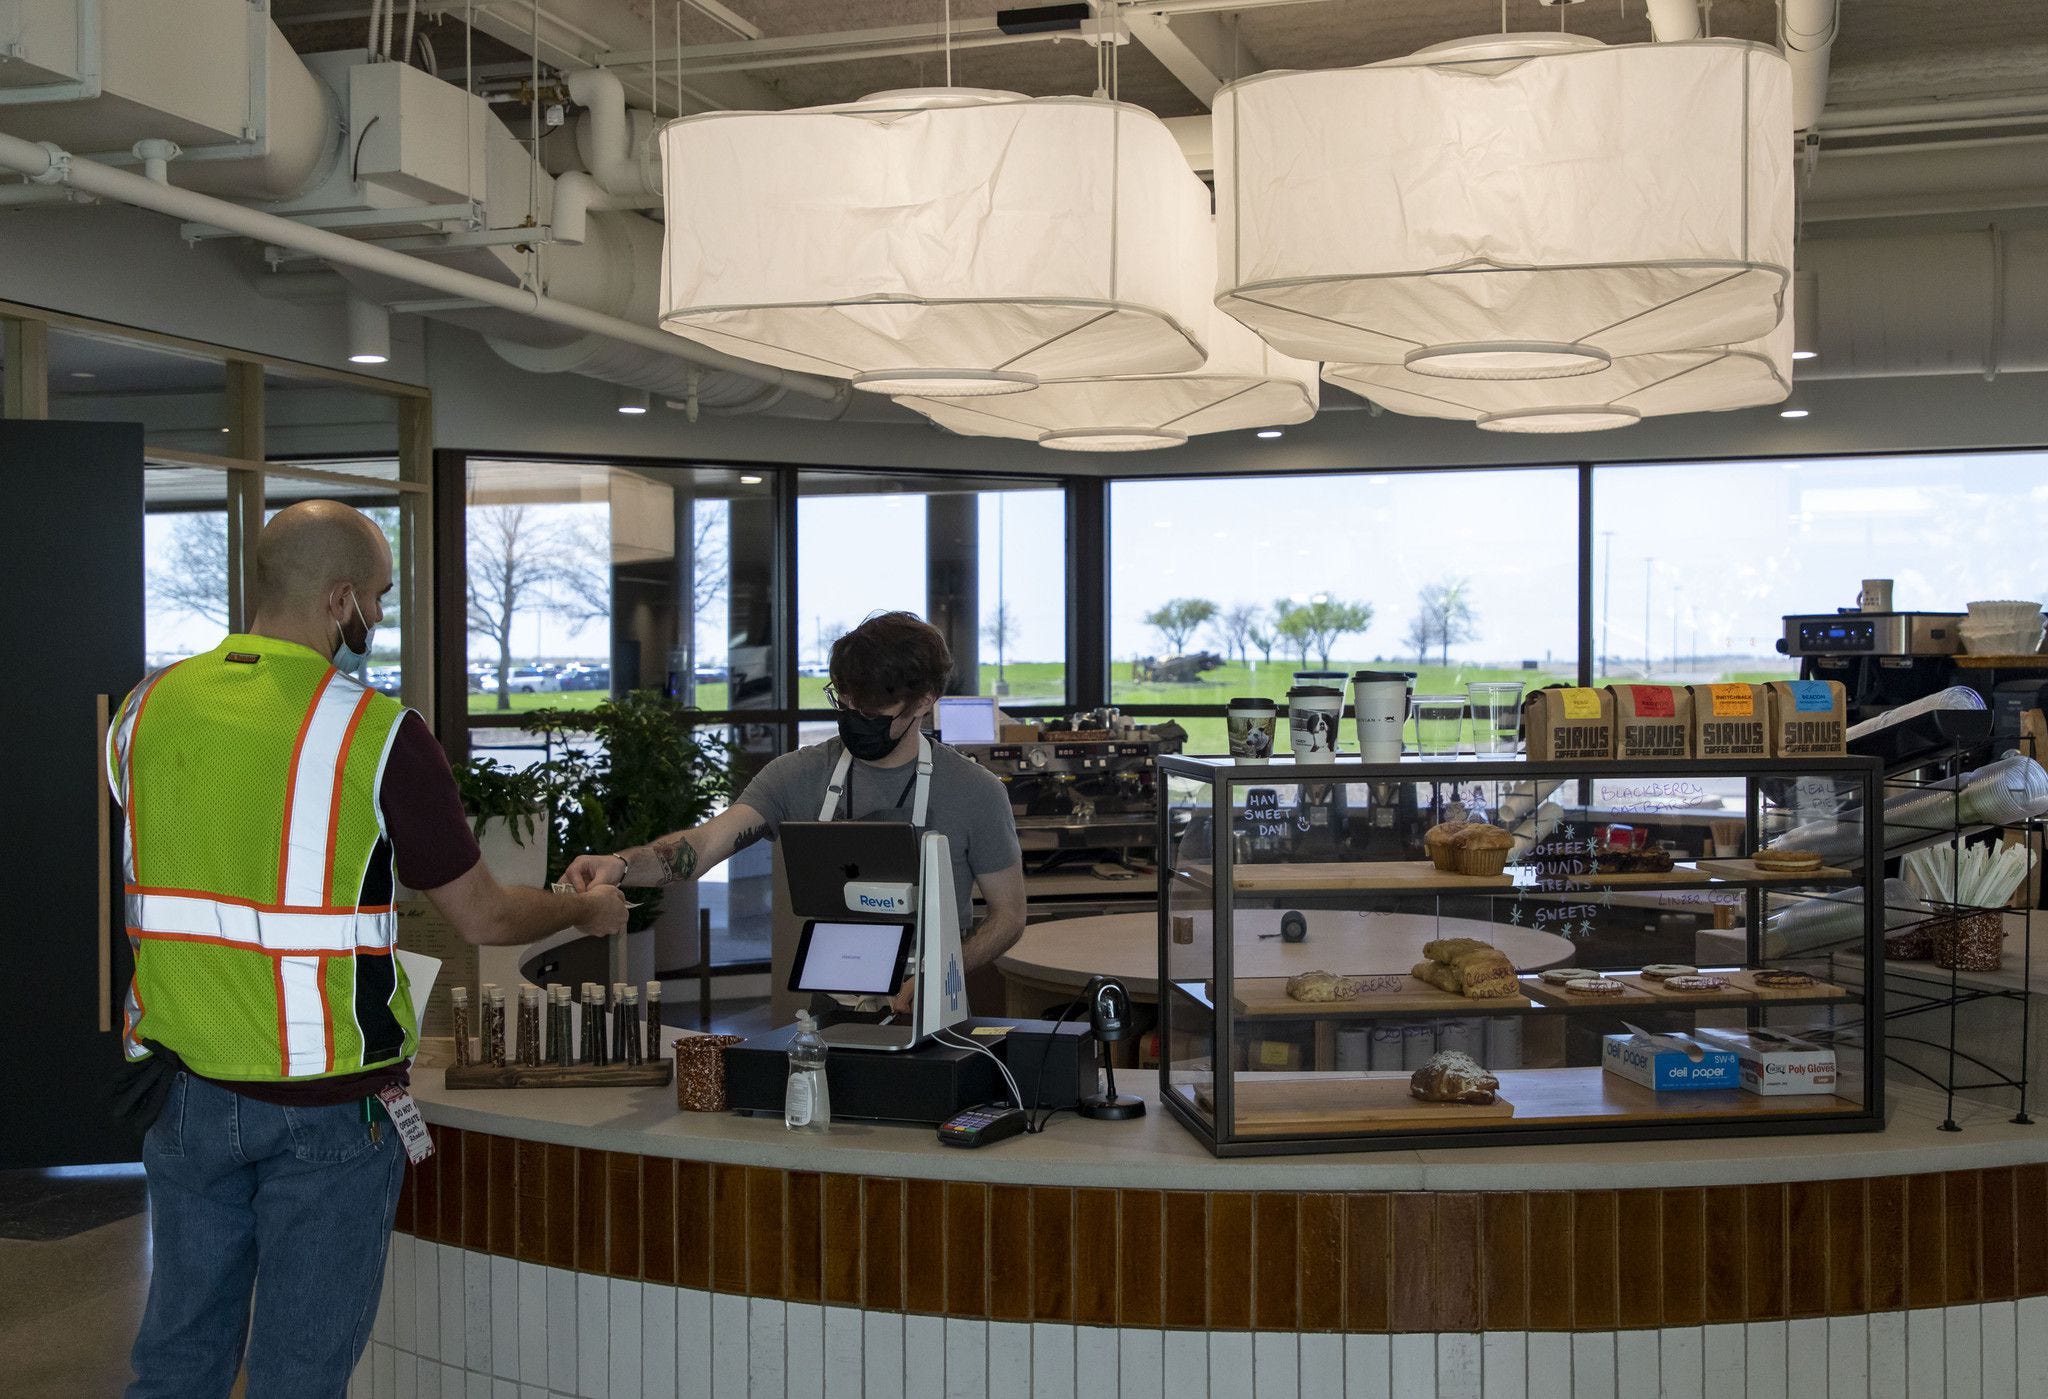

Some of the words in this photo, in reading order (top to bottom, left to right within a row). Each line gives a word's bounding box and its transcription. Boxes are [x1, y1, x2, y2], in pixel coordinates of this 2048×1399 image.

[1554, 726, 1609, 750] SIRIUS
[1625, 725, 1685, 748] SIRIUS
[1703, 722, 1763, 746] SIRIUS
[1785, 721, 1841, 744] SIRIUS
[1554, 750, 1578, 759] COFFEE
[1625, 748, 1651, 757] COFFEE
[1704, 746, 1729, 754] COFFEE
[1785, 745, 1810, 753] COFFEE
[1250, 793, 1285, 806] HAVE
[1601, 782, 1704, 802] BLACKBERRY
[1244, 809, 1292, 820] SWEET
[1259, 822, 1287, 836] DAY!
[1525, 842, 1584, 857] COFFEE
[1524, 860, 1584, 877] HOUND
[1537, 879, 1592, 892] TREATS
[860, 894, 895, 908] Revel
[1708, 888, 1746, 904] COOK
[1535, 905, 1597, 921] SWEETS
[1623, 1050, 1648, 1069] paper
[1669, 1067, 1688, 1078] deli
[1692, 1067, 1725, 1079] paper
[1788, 1064, 1807, 1075] Poly
[1808, 1064, 1836, 1073] Gloves
[394, 1109, 404, 1118] DO
[403, 1103, 413, 1114] NOT
[399, 1113, 421, 1131] OPERATE
